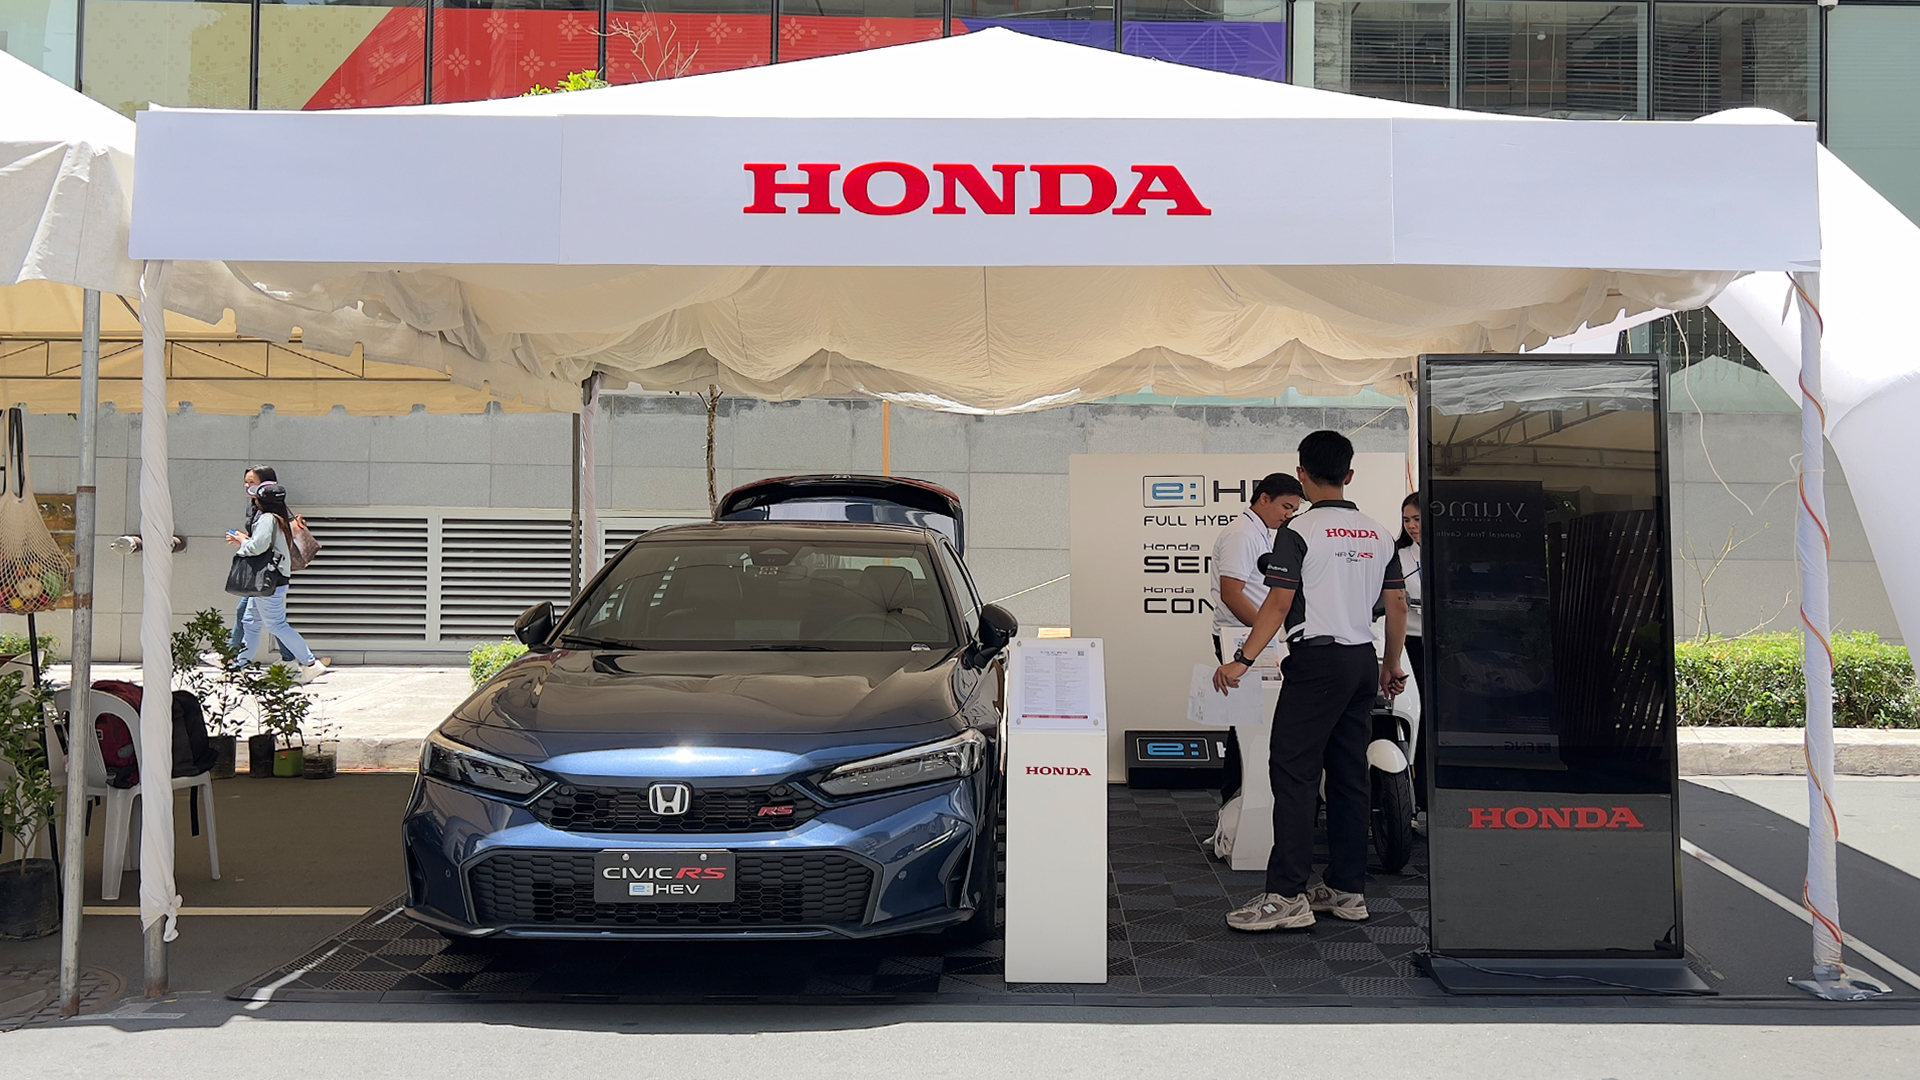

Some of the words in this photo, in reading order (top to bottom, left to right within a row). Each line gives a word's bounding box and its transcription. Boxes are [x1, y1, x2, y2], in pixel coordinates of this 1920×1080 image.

[743, 161, 1212, 216] HONDA
[1143, 515, 1187, 526] FULL
[1325, 528, 1379, 540] HONDA
[1143, 543, 1200, 551] Honda
[1025, 766, 1092, 776] HONDA
[757, 805, 794, 816] RS
[1468, 807, 1644, 829] HONDA
